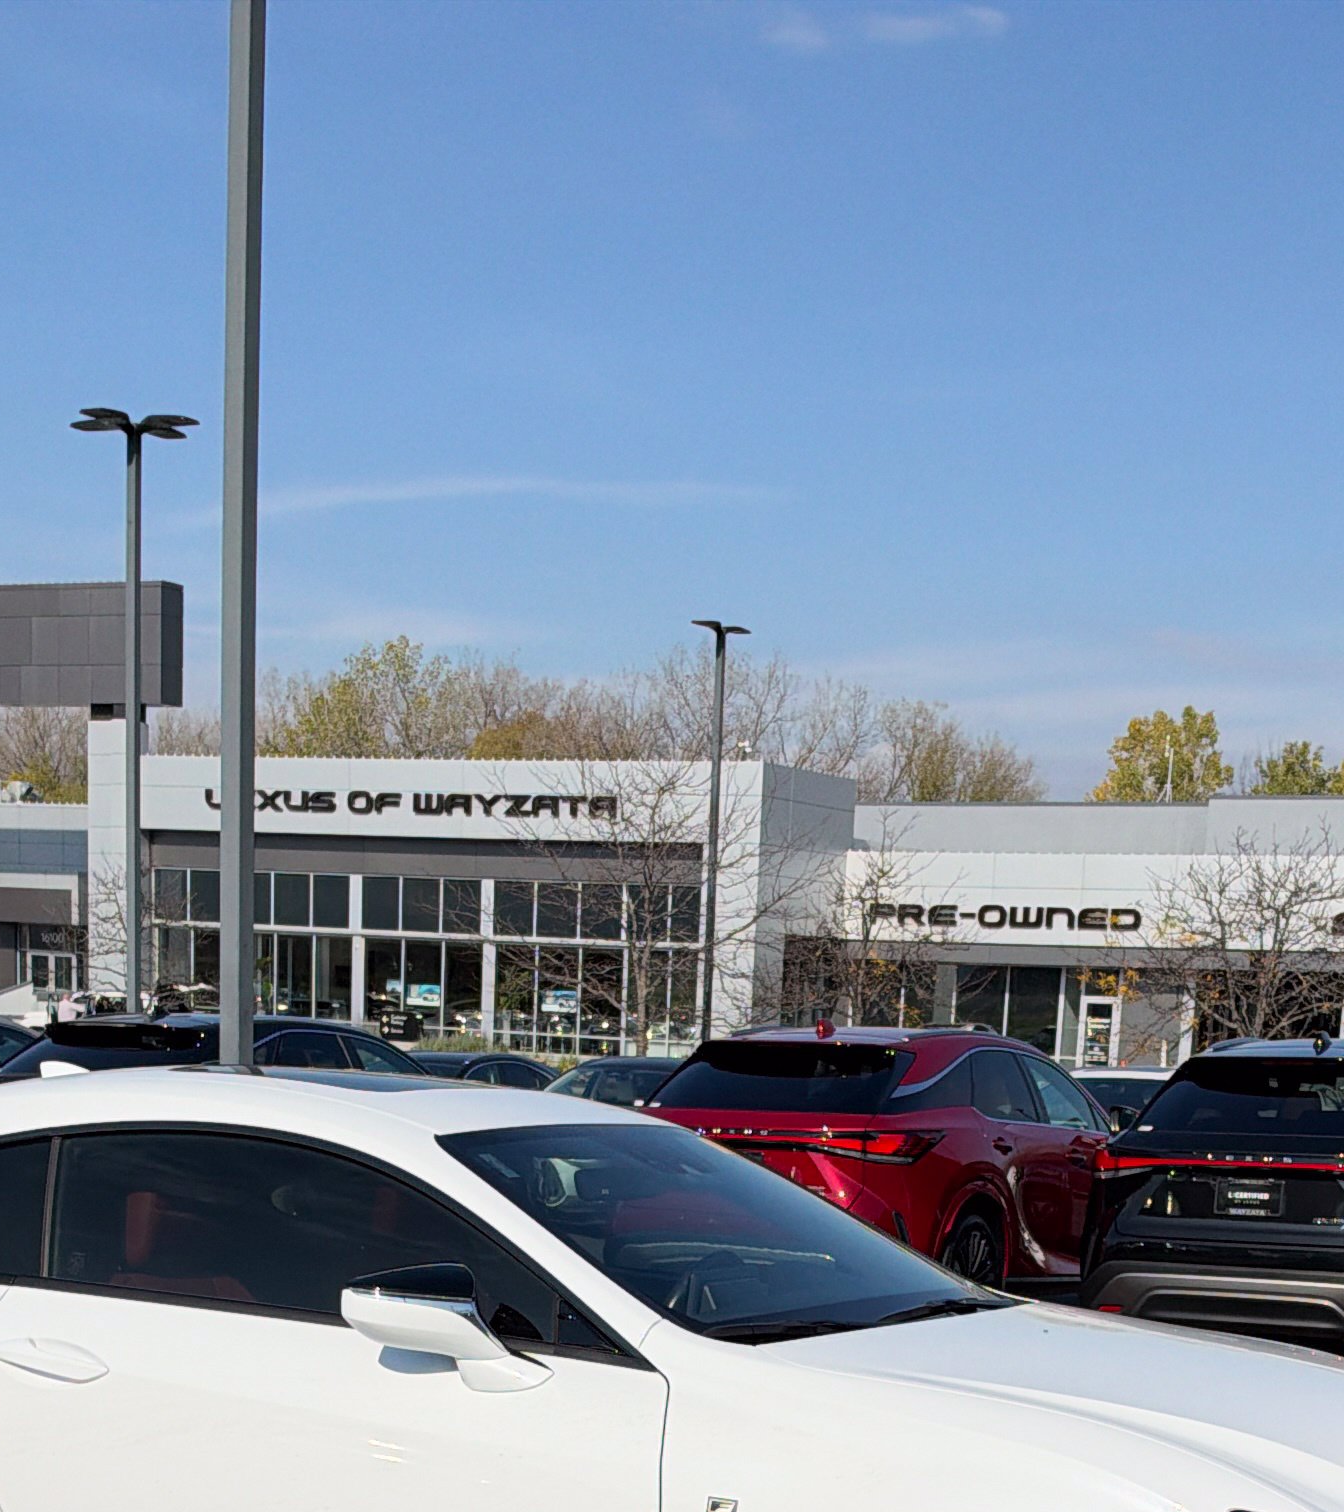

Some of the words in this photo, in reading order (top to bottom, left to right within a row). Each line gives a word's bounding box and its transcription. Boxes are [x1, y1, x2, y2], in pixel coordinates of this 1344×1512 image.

[205, 788, 337, 814] LXUS
[348, 790, 403, 815] OF
[413, 793, 618, 819] WAYZATA
[869, 903, 1142, 931] PRE-OWNED
